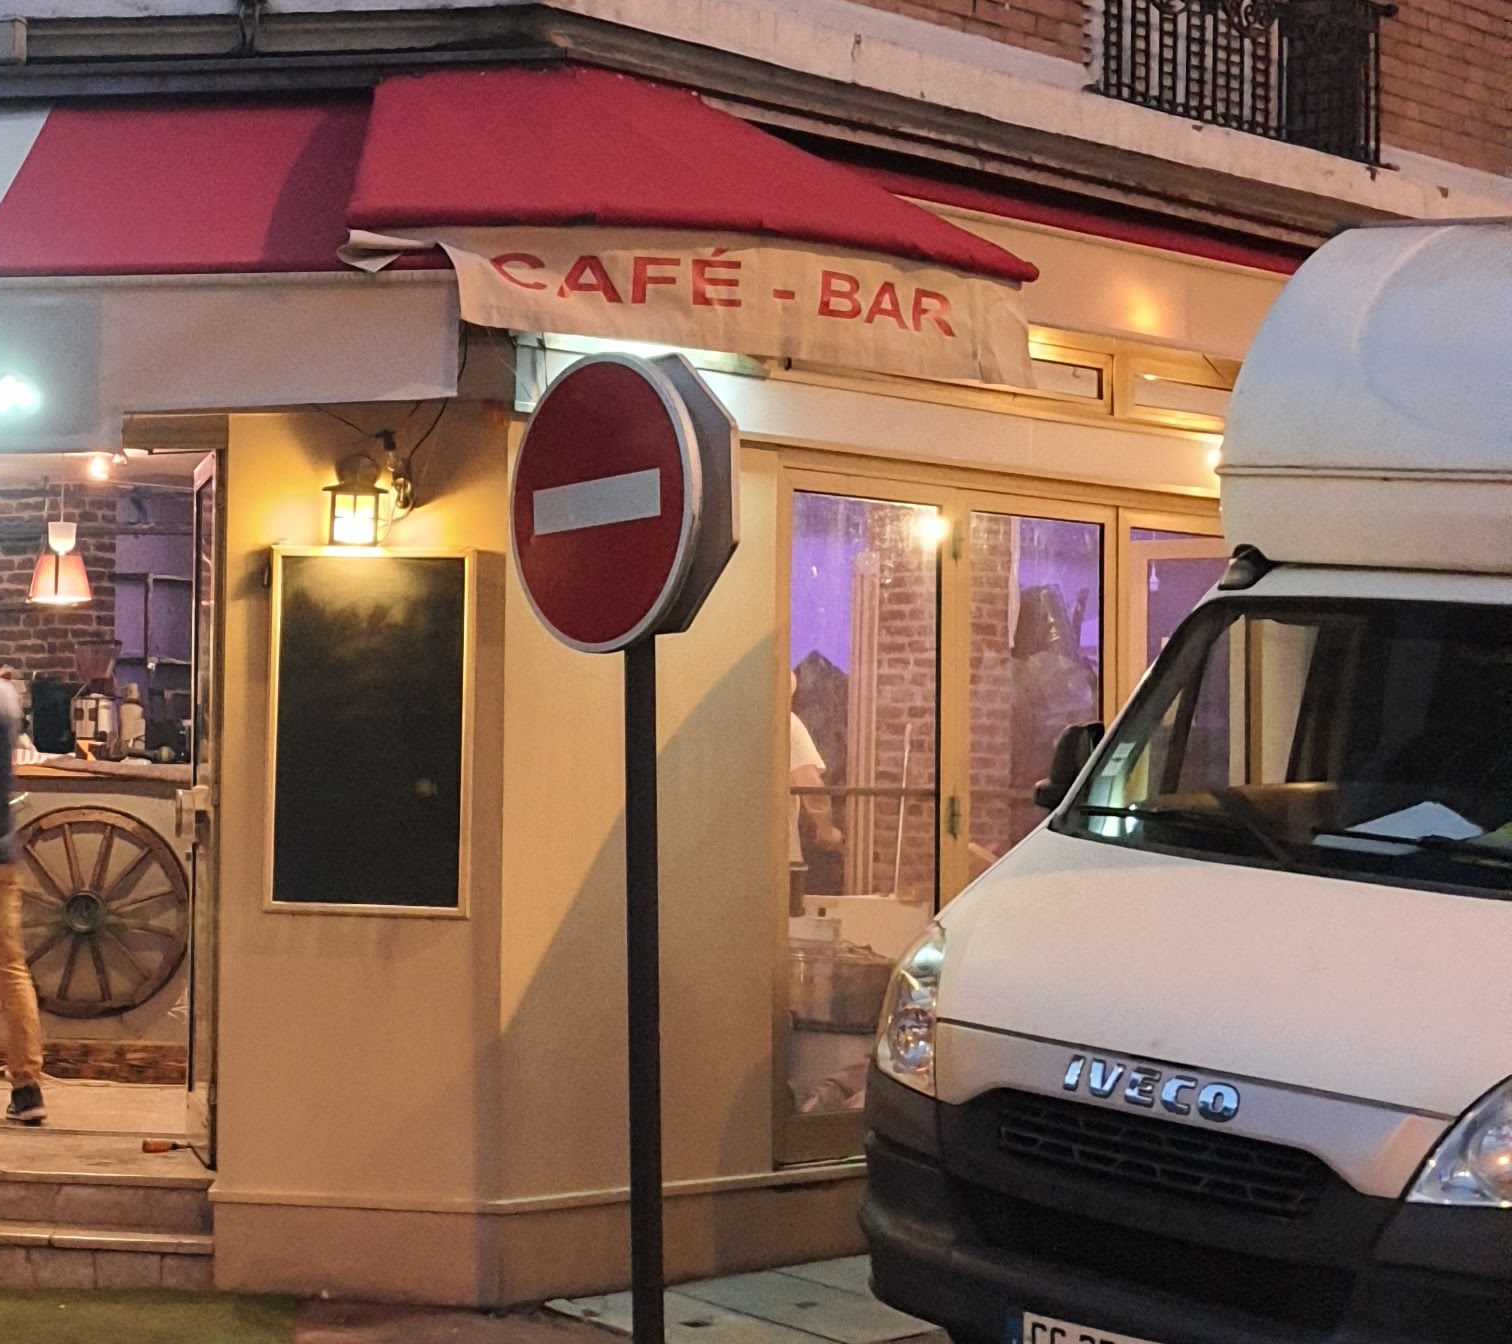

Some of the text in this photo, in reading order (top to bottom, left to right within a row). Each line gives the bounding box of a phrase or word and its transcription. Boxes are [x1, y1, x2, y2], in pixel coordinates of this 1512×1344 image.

[490, 247, 742, 308] CAFÉ
[817, 269, 957, 338] BAR
[1063, 1054, 1241, 1123] IVECO
